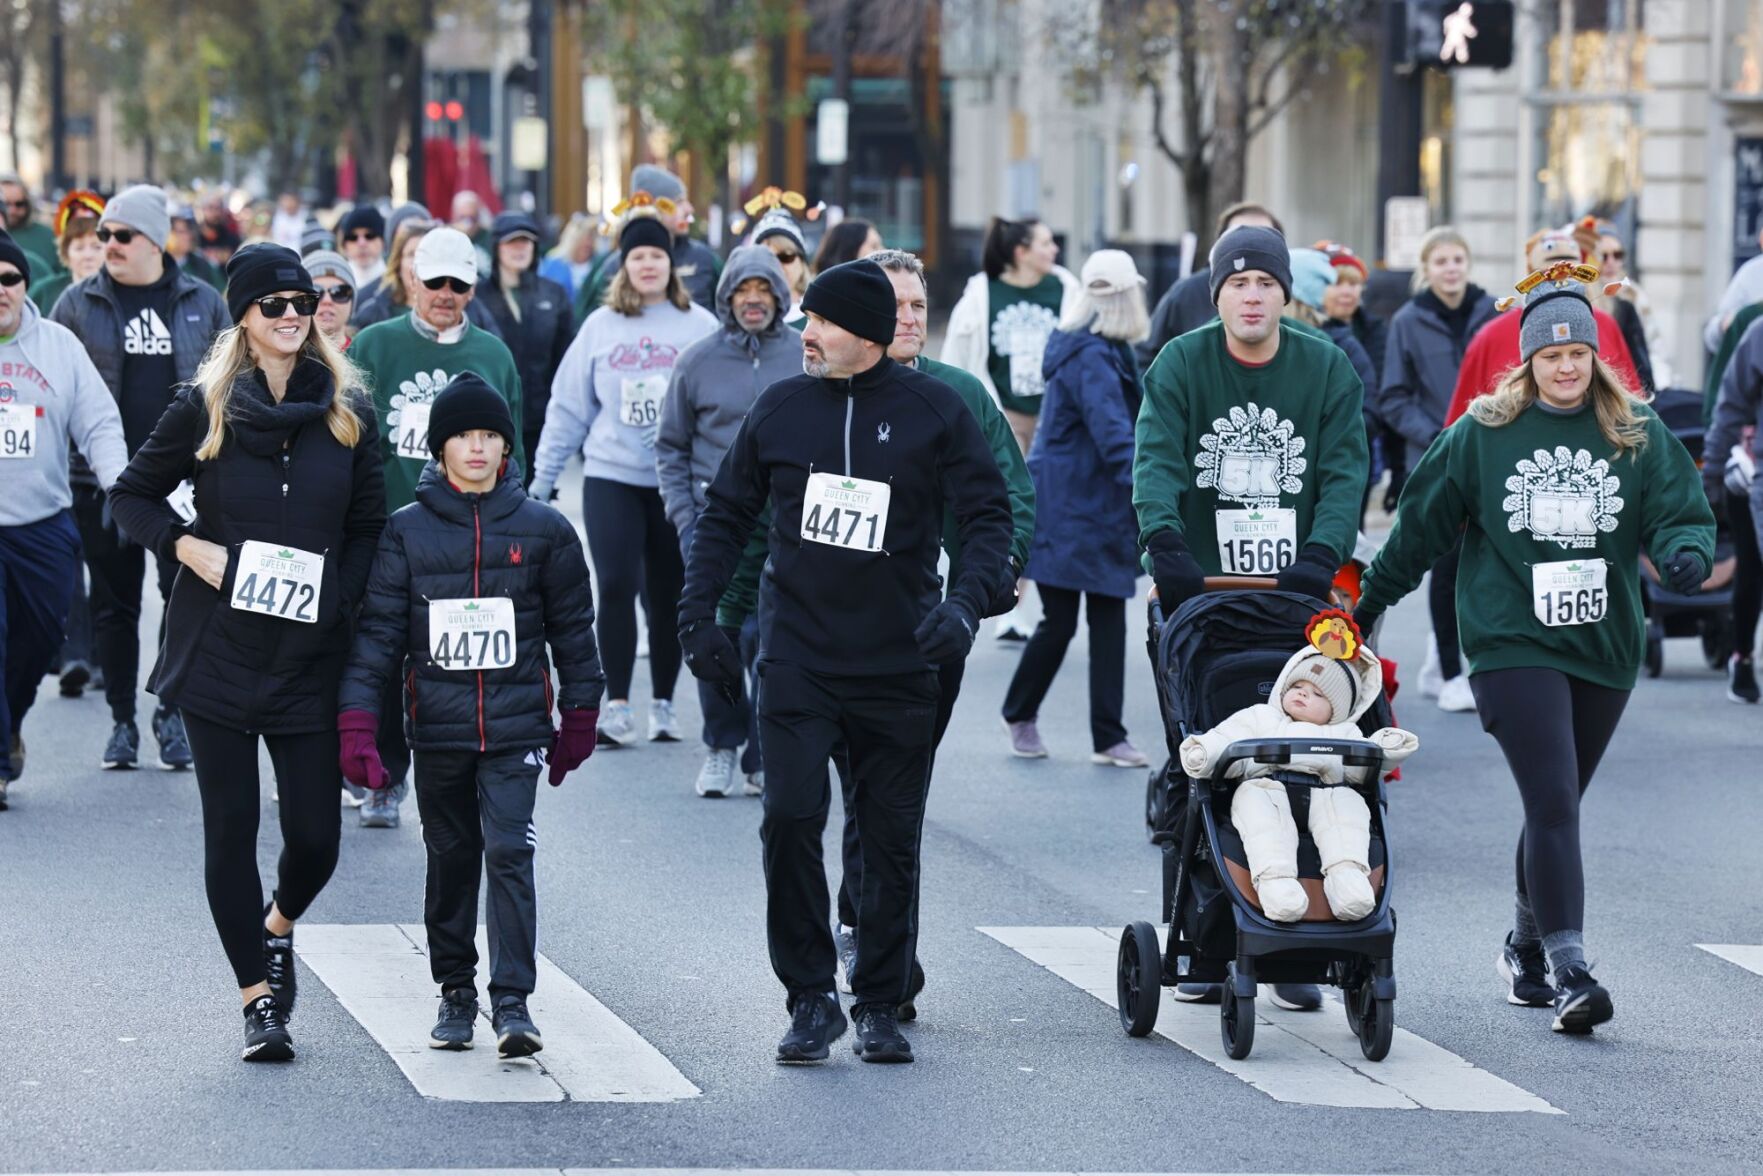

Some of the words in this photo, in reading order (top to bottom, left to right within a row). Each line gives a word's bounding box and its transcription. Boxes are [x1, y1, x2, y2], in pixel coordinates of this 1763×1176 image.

[1219, 456, 1281, 496] 5K
[824, 488, 850, 501] QUEEN
[851, 493, 871, 504] CITY
[804, 503, 879, 549] 4471
[1234, 523, 1259, 533] QUEEN
[1261, 523, 1278, 532] CITY
[1530, 495, 1597, 535] 5K
[1223, 538, 1292, 573] 1566
[1571, 541, 1597, 549] 2022
[260, 558, 286, 571] QUEEN
[289, 562, 306, 575] CITY
[1552, 575, 1578, 585] QUEEN
[1580, 573, 1594, 584] CITY
[236, 572, 315, 621] 4472
[1541, 588, 1603, 624] 1565
[448, 613, 474, 624] QUEEN
[478, 613, 495, 624] CITY
[434, 629, 512, 667] 4470
